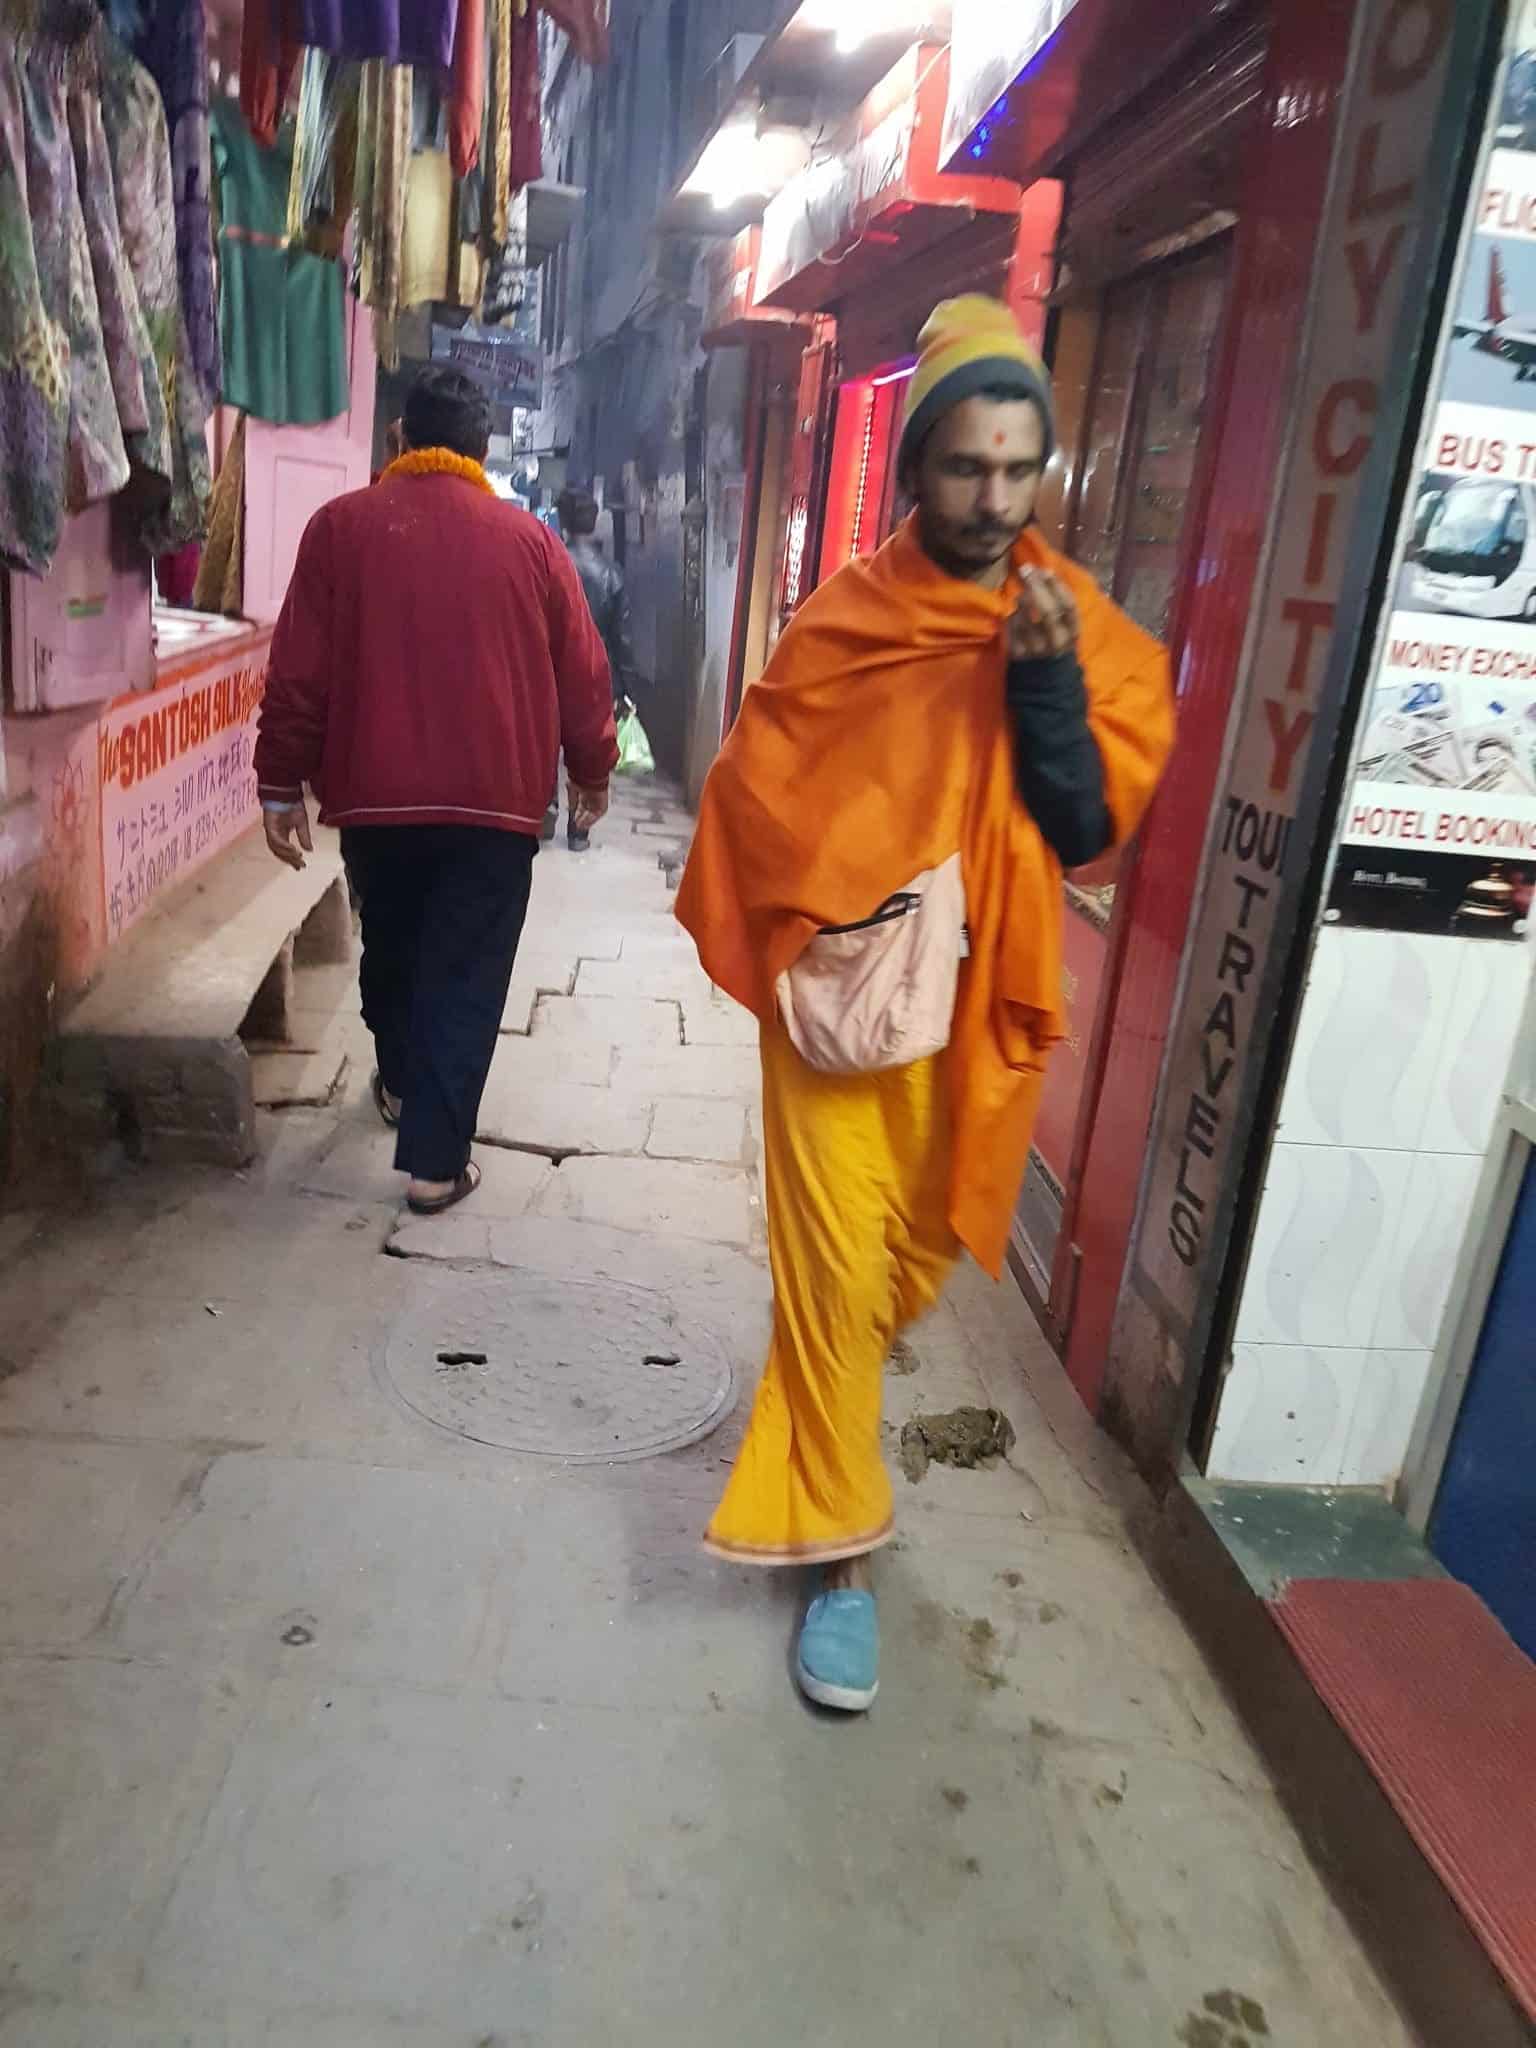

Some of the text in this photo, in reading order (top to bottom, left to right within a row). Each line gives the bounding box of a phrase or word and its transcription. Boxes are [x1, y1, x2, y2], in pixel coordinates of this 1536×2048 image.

[1438, 433, 1505, 473] BUS
[1263, 375, 1382, 795] CITY
[1390, 640, 1470, 673] MONEY
[119, 688, 211, 789] SANTOSH
[213, 670, 241, 732] SILK
[1350, 805, 1427, 839] HOTEL
[1167, 874, 1269, 1268] TRAVELS
